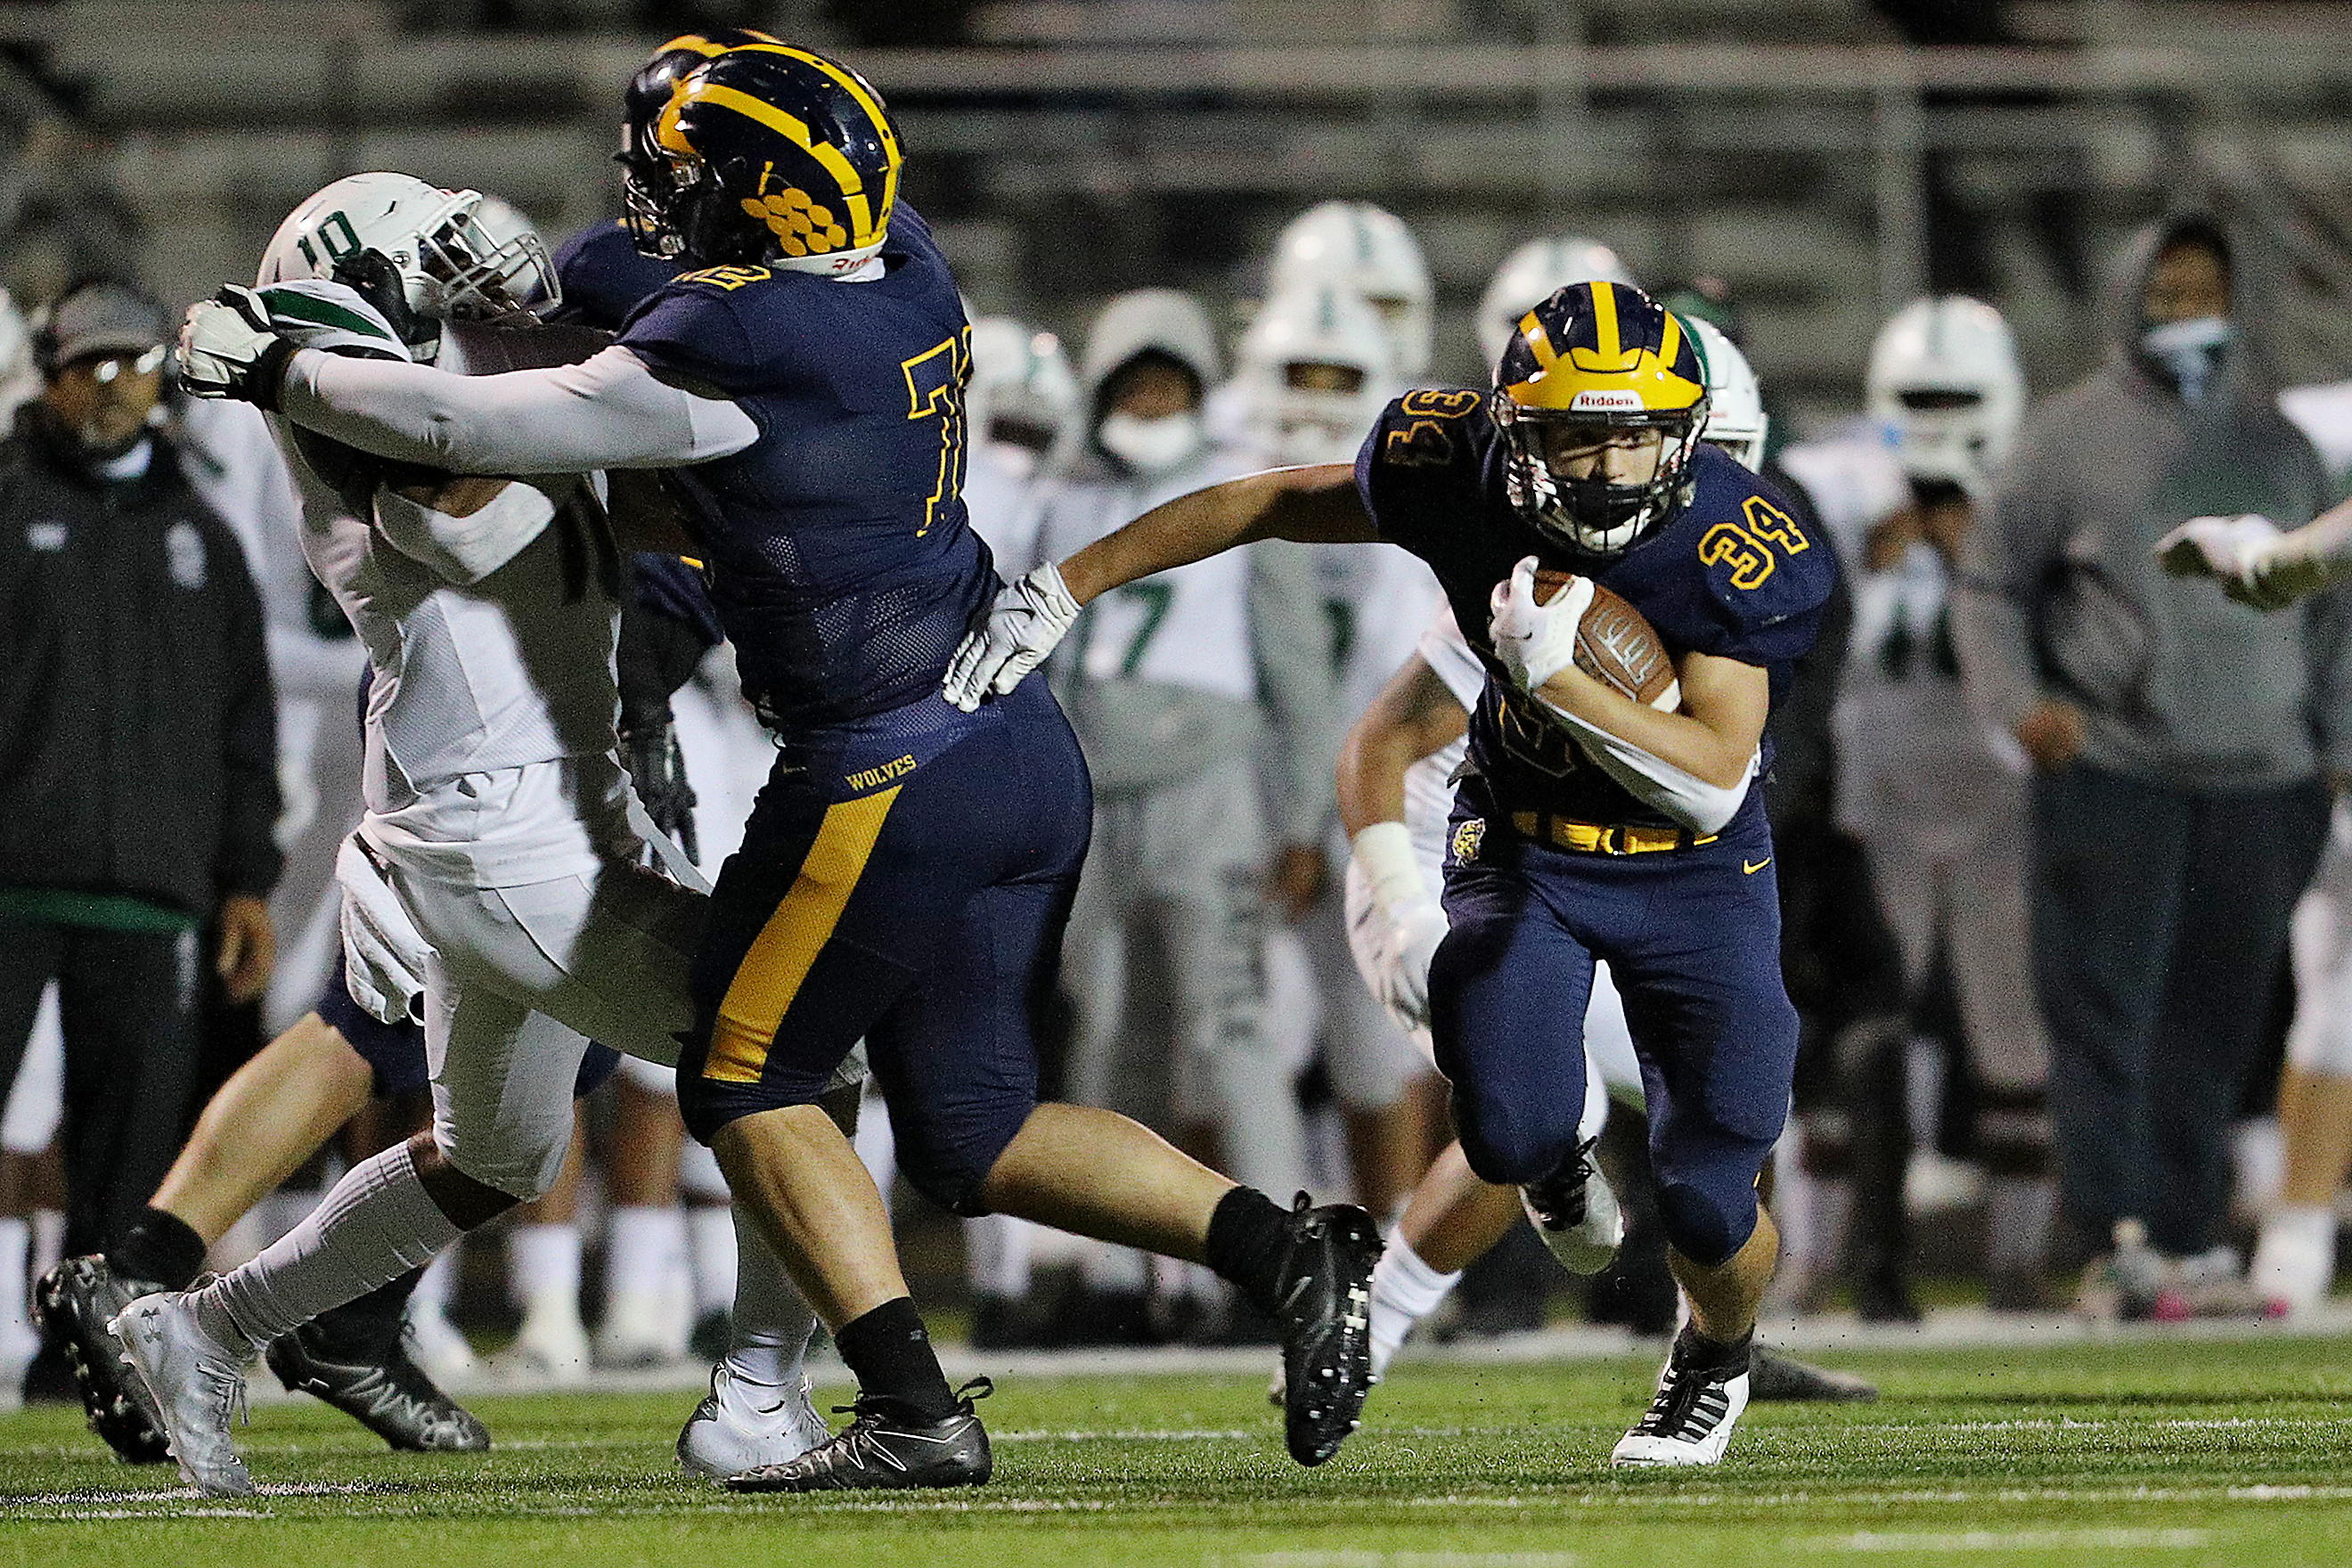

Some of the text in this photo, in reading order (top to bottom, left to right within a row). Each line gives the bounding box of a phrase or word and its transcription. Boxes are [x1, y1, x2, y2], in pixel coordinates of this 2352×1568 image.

[297, 210, 362, 273] 10
[1696, 494, 1810, 591] 34
[844, 754, 918, 792] WOLVES
